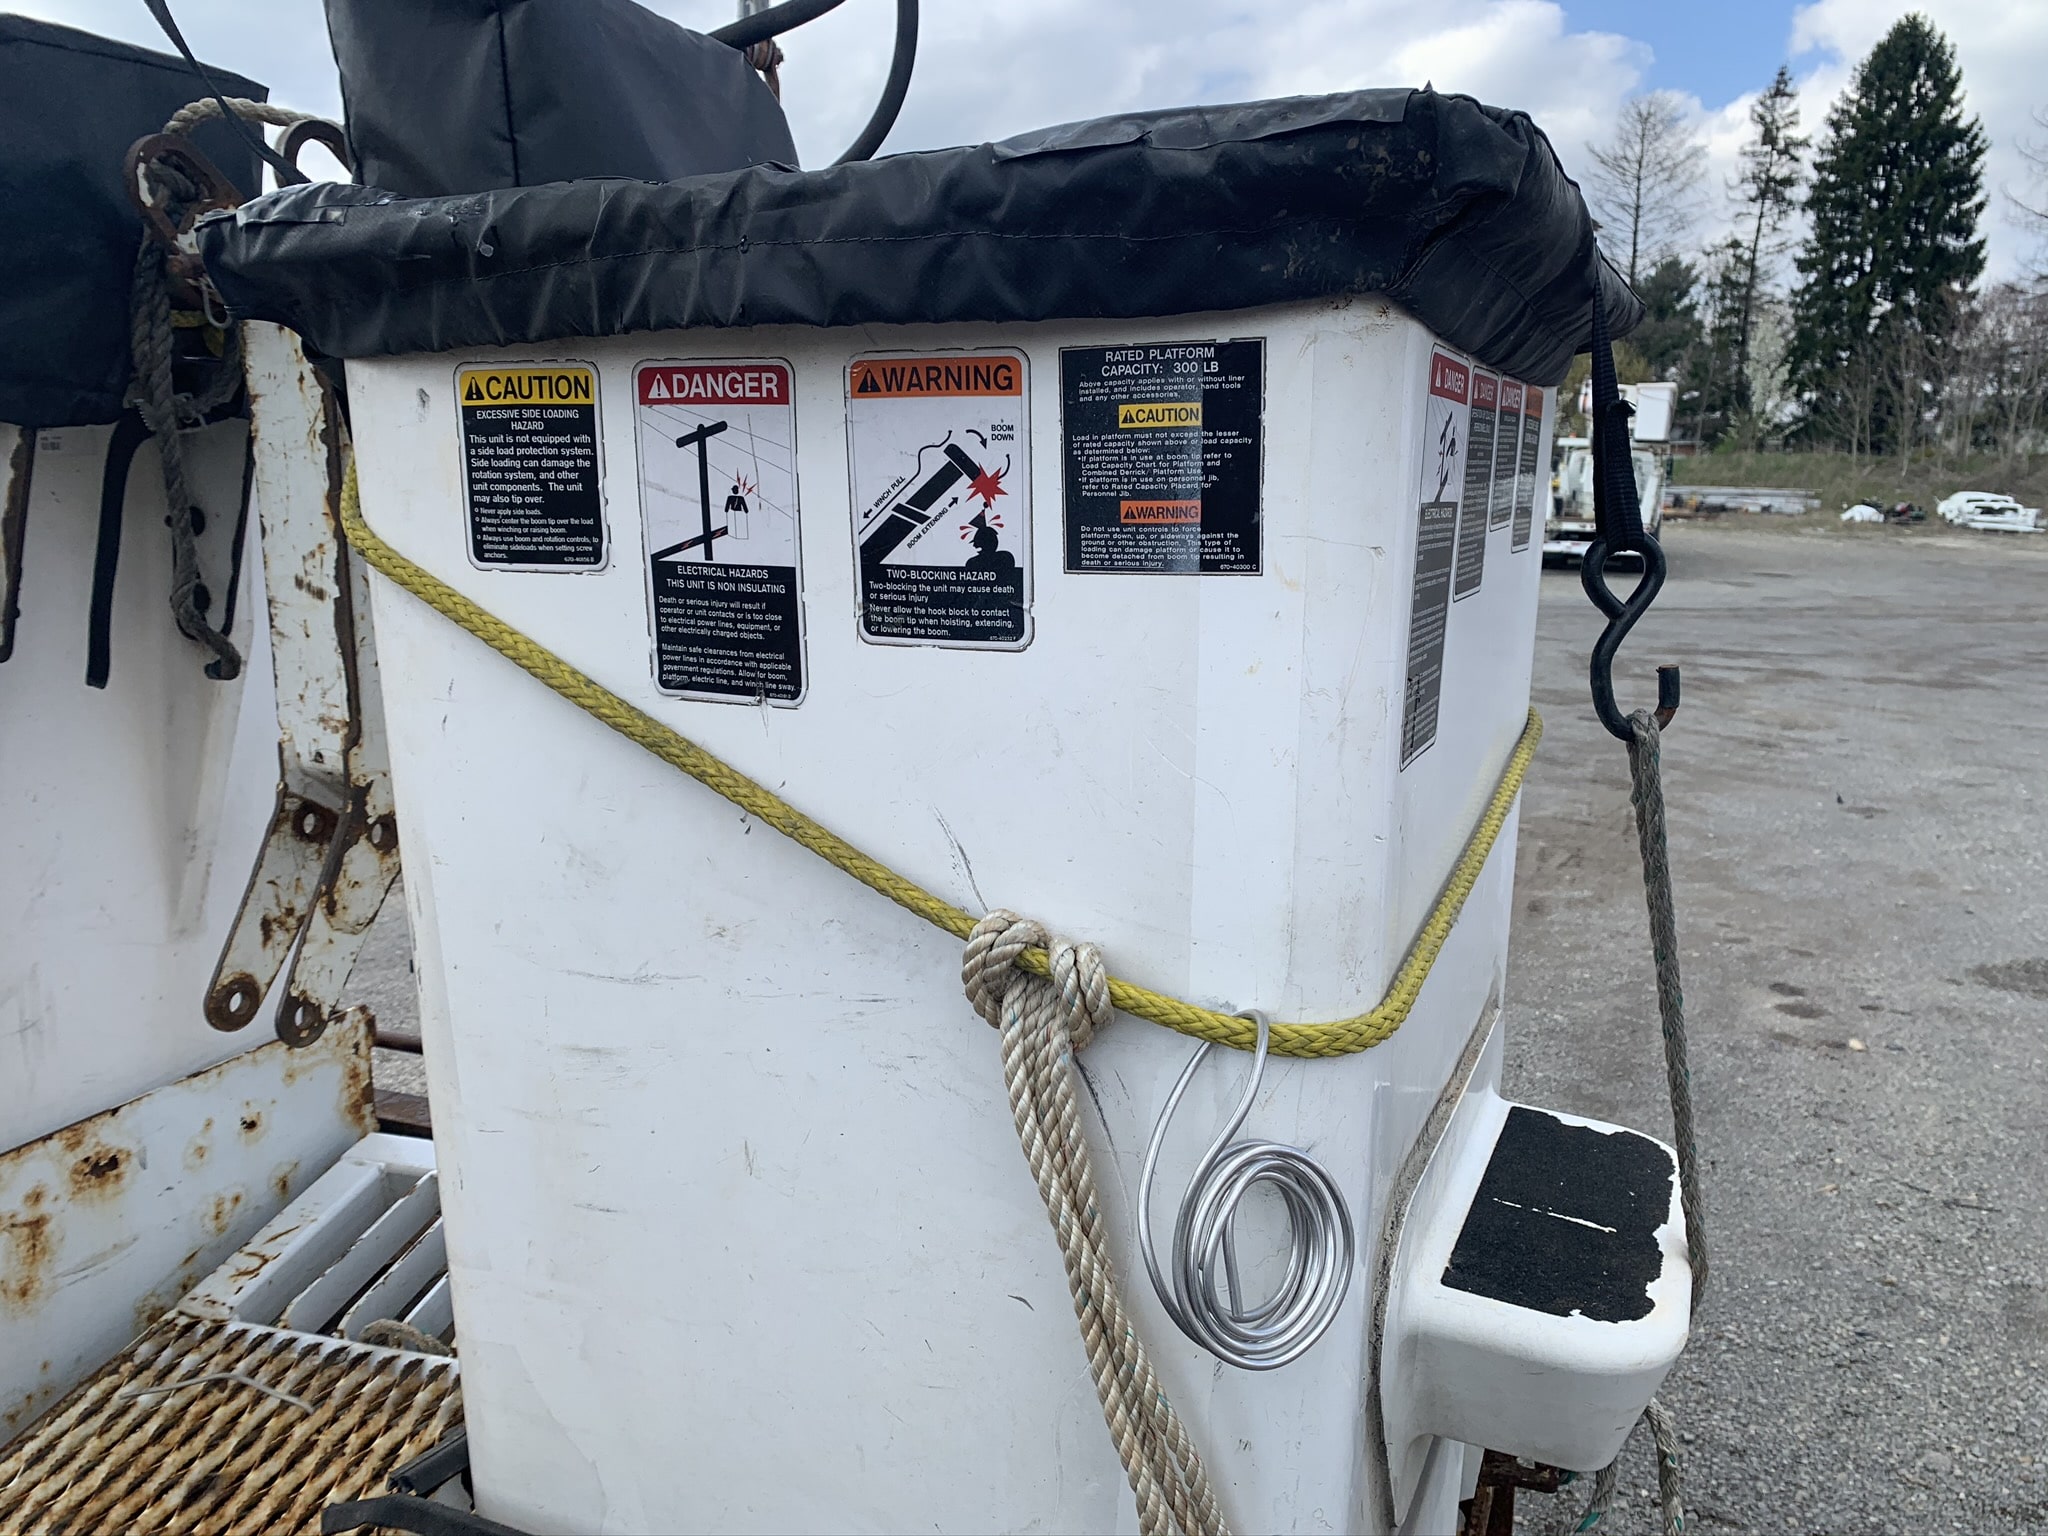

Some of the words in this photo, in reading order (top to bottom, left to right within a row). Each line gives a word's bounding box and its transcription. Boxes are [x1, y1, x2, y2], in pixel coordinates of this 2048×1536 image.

[1105, 351, 1143, 362] RATED
[1149, 348, 1215, 360] PLATFORM
[1101, 364, 1162, 376] CAPACITY:
[1173, 363, 1197, 374] 300
[1203, 362, 1219, 373] LB
[882, 365, 1013, 393] WARNING
[1444, 368, 1465, 395] DANGER
[486, 376, 590, 400] CAUTION
[671, 373, 779, 398] DANGER
[476, 411, 519, 419] EXCESSIVE
[542, 410, 579, 418] LOADING
[1135, 408, 1199, 422] CAUTION
[511, 422, 544, 430] HAZARD
[469, 435, 486, 443] This
[488, 435, 503, 443] unit
[505, 435, 513, 443] is
[515, 435, 529, 443] not
[531, 435, 570, 445] equipped
[572, 435, 590, 443] with
[1101, 433, 1131, 441] platform
[1219, 438, 1252, 446] capacity
[477, 447, 494, 455] side
[496, 447, 513, 455] load
[516, 447, 558, 457] protection
[560, 447, 594, 457] system.
[471, 459, 488, 467] Side
[490, 459, 520, 469] loading
[540, 459, 574, 469] damage
[576, 459, 590, 467] the
[1101, 462, 1132, 470] Capacity
[472, 471, 502, 479] rotation
[504, 471, 536, 481] system,
[539, 471, 554, 479] and
[556, 471, 579, 479] other
[473, 483, 487, 491] unit
[489, 483, 542, 493] components.
[549, 483, 564, 491] The
[566, 483, 583, 491] unit
[873, 488, 892, 508] WINCH
[890, 475, 906, 491] PULL
[1135, 483, 1167, 491] Capacity
[474, 496, 489, 505] may
[492, 495, 509, 503] also
[511, 495, 522, 505] tip
[1136, 506, 1198, 520] WARNING
[906, 533, 922, 549] BOOM
[921, 507, 949, 534] EXTENDING
[677, 566, 726, 576] ELECTRICAL
[728, 568, 768, 578] HAZARDS
[887, 570, 956, 580] TWO-BLOCKING
[959, 571, 997, 581] HAZARD
[667, 579, 684, 588] THIS
[686, 580, 704, 589] UNIT
[707, 581, 715, 589] IS
[717, 582, 735, 590] NON
[737, 583, 786, 593] INSULATING
[869, 582, 916, 593] Two-blocking
[918, 583, 930, 591] the
[949, 585, 965, 594] may
[967, 585, 990, 593] cause
[992, 585, 1014, 593] death
[659, 596, 676, 604] Death
[686, 598, 708, 606] serious
[710, 599, 727, 608] injury
[741, 601, 759, 609] result
[879, 592, 906, 601] serious
[908, 593, 929, 603] injury
[660, 607, 684, 616] operator
[707, 609, 734, 617] contacts
[764, 612, 782, 620] close
[870, 605, 890, 613] Never
[893, 605, 911, 613] allow
[913, 606, 925, 614] the
[927, 606, 946, 614] hook
[948, 607, 969, 615] block
[971, 608, 978, 616] to
[981, 608, 1010, 617] contact
[668, 616, 695, 625] electrical
[697, 619, 716, 628] power
[717, 620, 734, 629] lines,
[736, 621, 771, 631] equipment,
[870, 615, 882, 623] the
[884, 615, 904, 623] boom
[906, 616, 916, 626] tip
[918, 616, 938, 625] when
[940, 617, 972, 628] hoisting,
[974, 618, 1014, 629] extending,
[678, 626, 710, 637] electrically
[712, 628, 737, 639] charged
[739, 630, 765, 641] objects.
[913, 626, 925, 634] the
[927, 627, 951, 636] boom.
[662, 644, 687, 652] Maintain
[688, 646, 701, 654] safe
[703, 647, 737, 656] clearances
[755, 651, 784, 660] electrical
